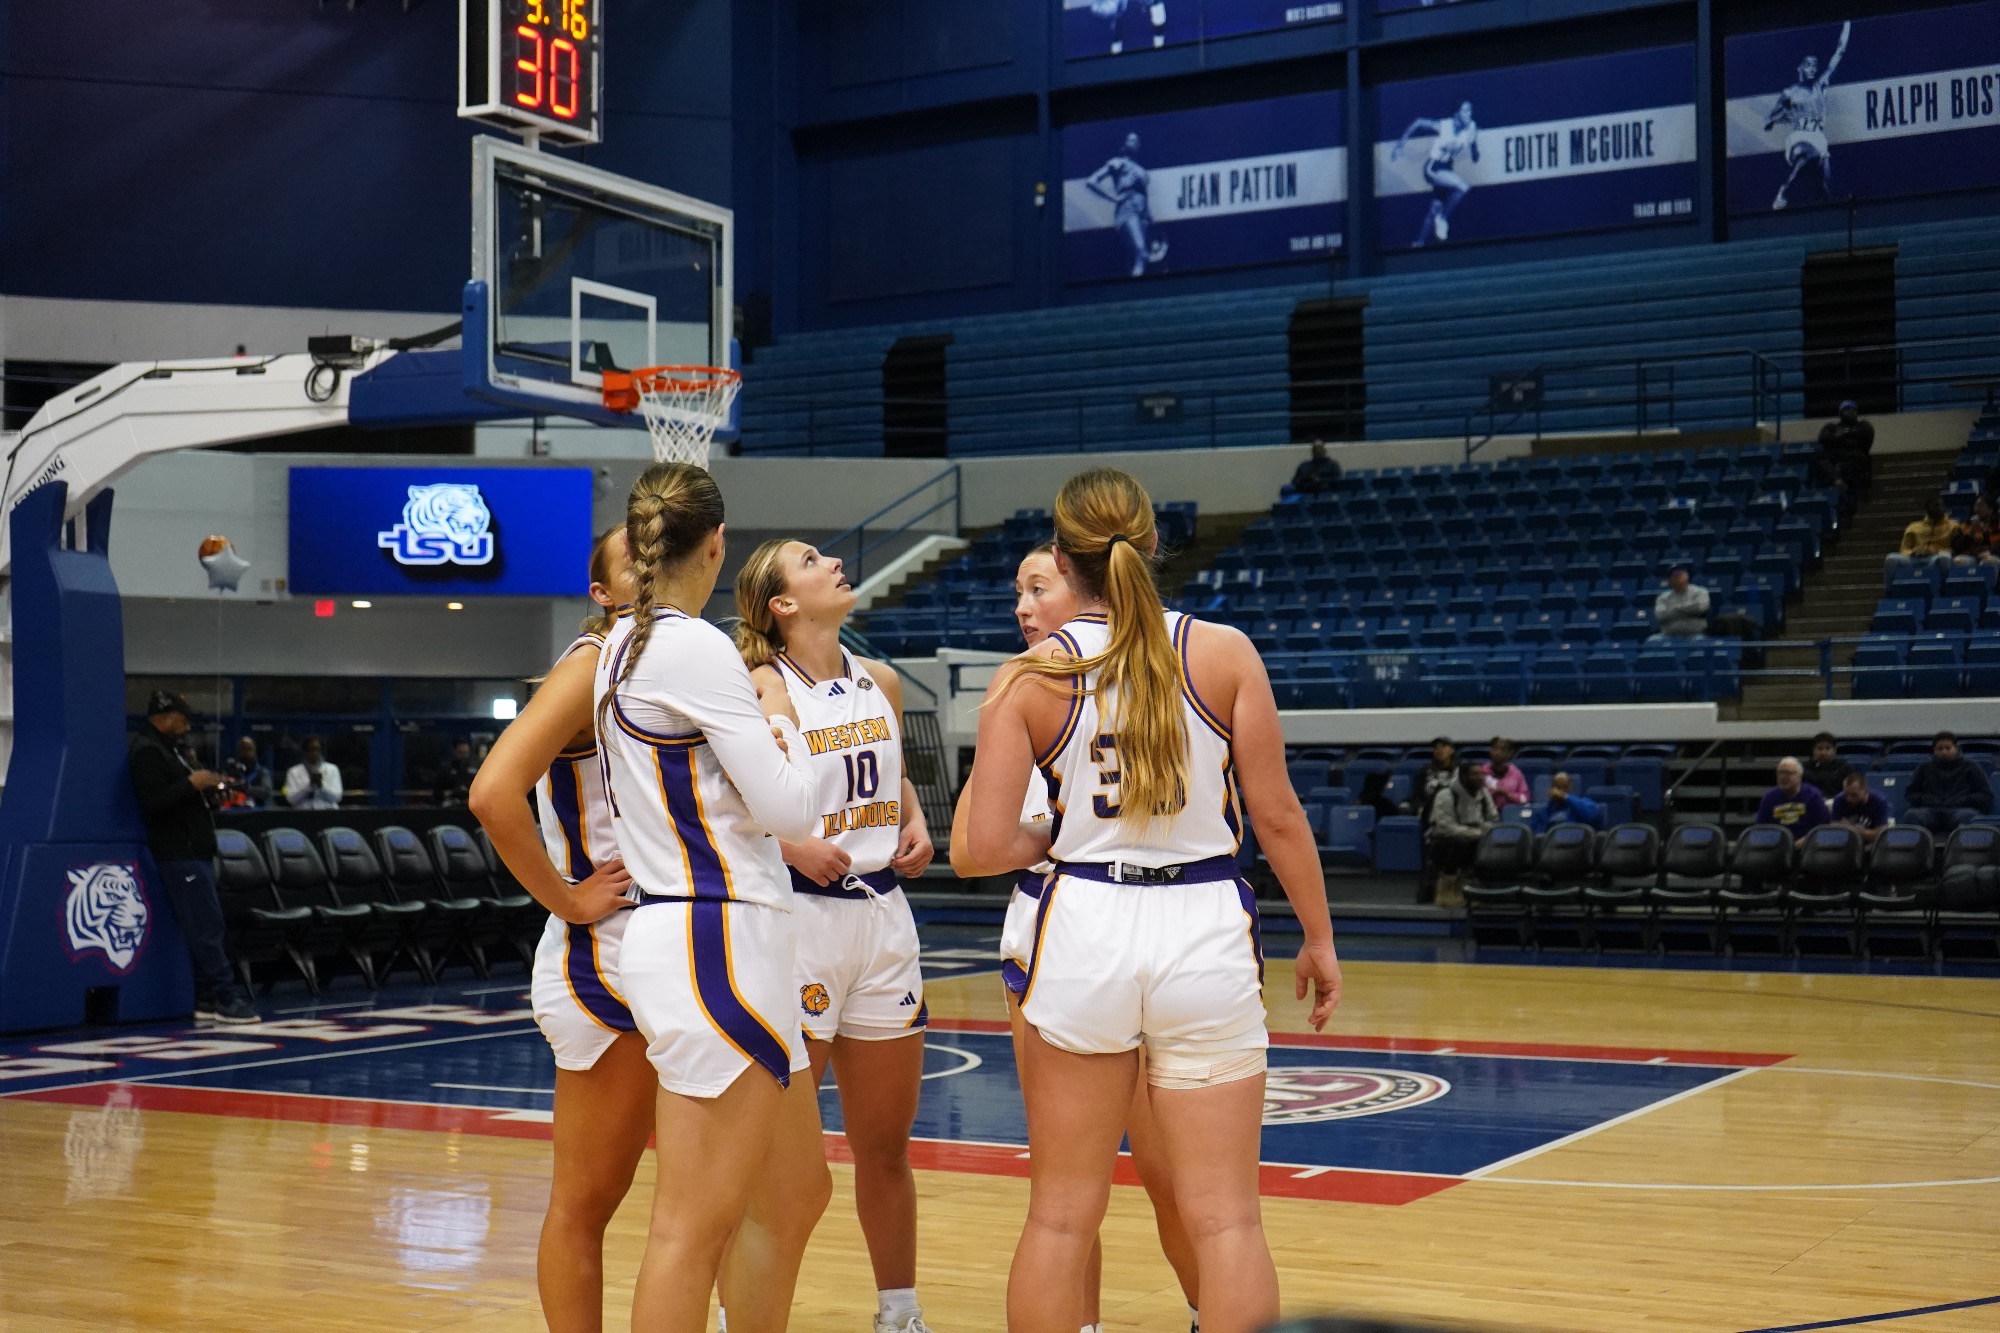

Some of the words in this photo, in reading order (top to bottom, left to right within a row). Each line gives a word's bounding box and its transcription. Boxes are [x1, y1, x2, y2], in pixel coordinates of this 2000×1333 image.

[517, 26, 579, 118] 30
[1866, 82, 1938, 130] RALPH
[1505, 132, 1558, 173] EDITH
[1570, 119, 1654, 166] MCGUIRE
[1178, 172, 1220, 210] JEAN
[1230, 162, 1297, 204] PATTON
[15, 454, 66, 506] DING
[843, 750, 880, 803] 10
[1089, 732, 1189, 820] 3
[822, 801, 899, 840] ILLINOIS
